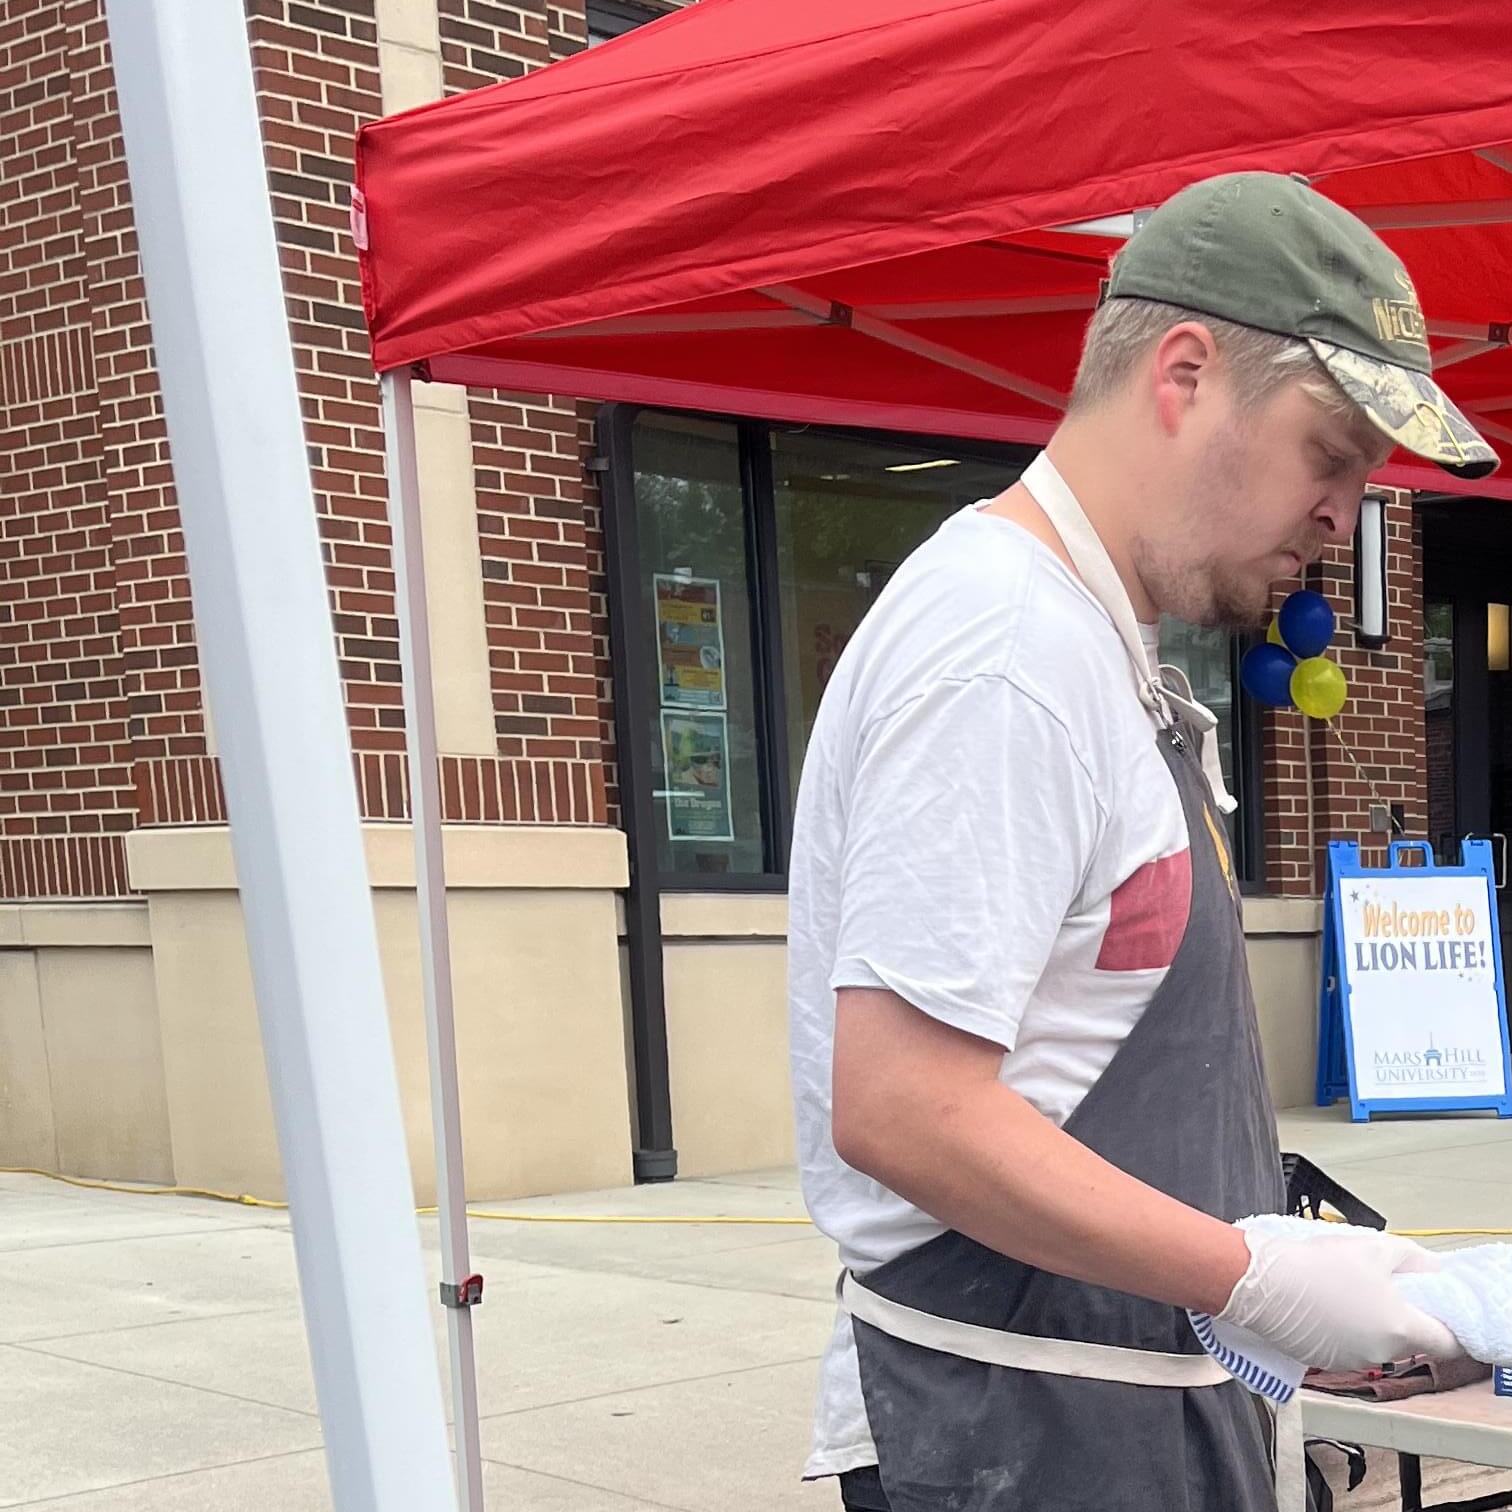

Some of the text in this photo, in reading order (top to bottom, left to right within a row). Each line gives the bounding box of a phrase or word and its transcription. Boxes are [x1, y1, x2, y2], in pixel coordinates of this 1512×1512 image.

[1363, 901, 1475, 937] Welcome to
[1354, 940, 1486, 971] LION LIFE!
[1374, 1047, 1484, 1065] MARS HILL
[1376, 1067, 1469, 1082] UNIVERSITY
